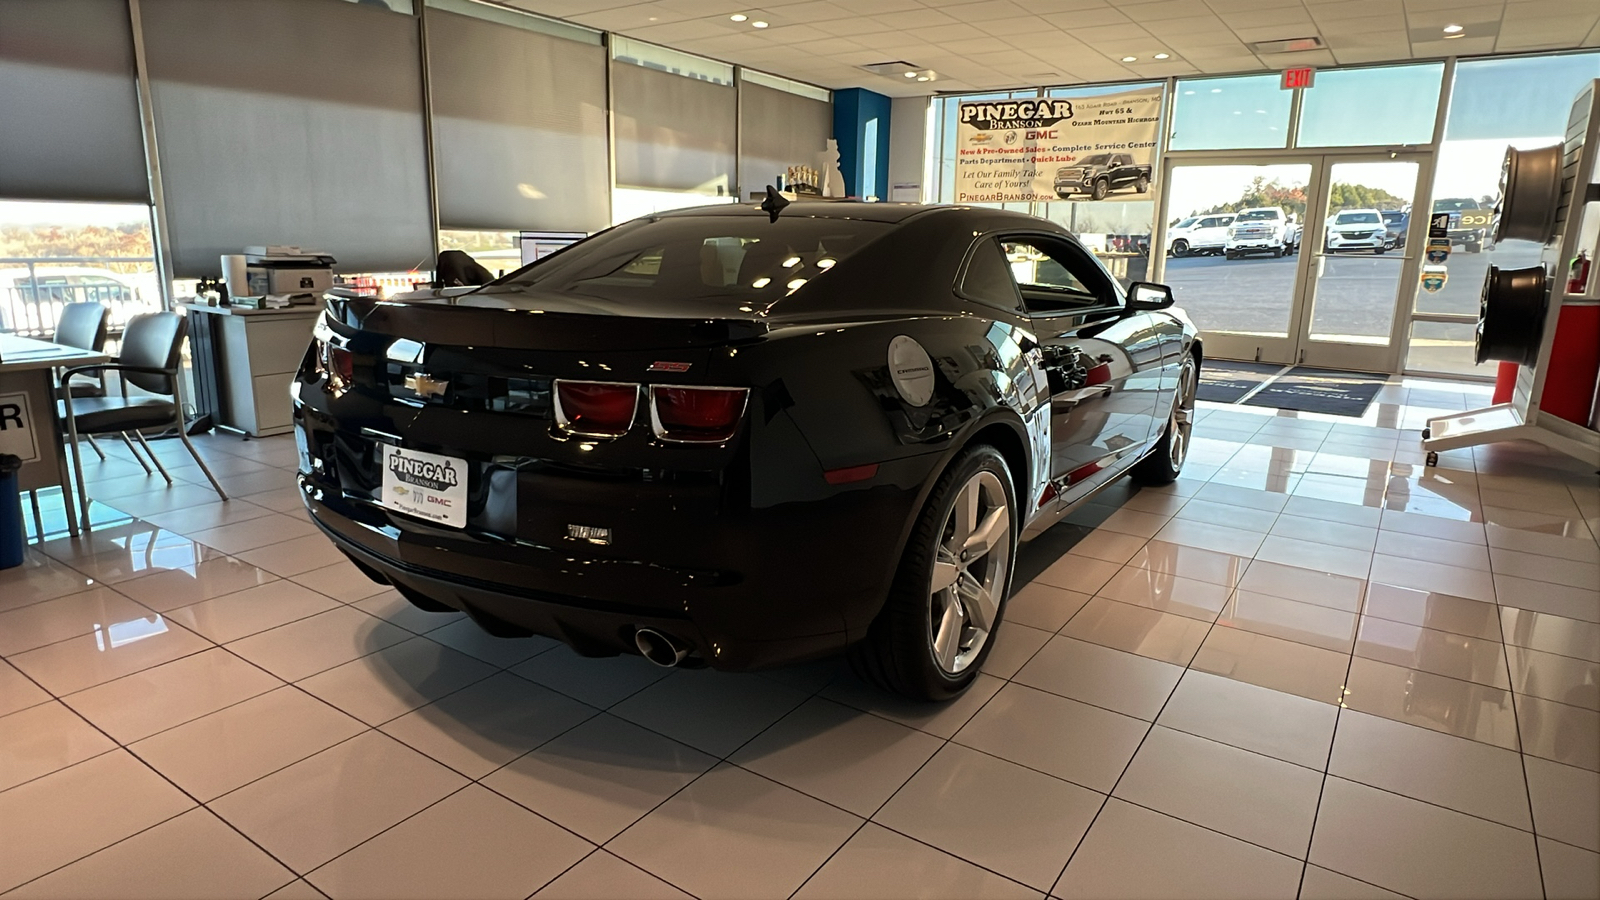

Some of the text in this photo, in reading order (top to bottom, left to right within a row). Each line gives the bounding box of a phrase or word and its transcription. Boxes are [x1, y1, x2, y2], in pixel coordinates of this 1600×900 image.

[1286, 68, 1311, 87] EXIT
[962, 101, 1072, 122] PINEGAR
[989, 119, 1043, 129] BRANSON
[1025, 130, 1058, 140] GMC
[983, 147, 1024, 155] Pre-Owned
[1052, 145, 1092, 153] Complete
[980, 157, 1026, 165] Department
[963, 171, 975, 179] Let
[993, 169, 1020, 178] Family
[1022, 170, 1043, 178] Take
[974, 180, 1030, 189] Care of Yours!
[390, 455, 457, 485] PINEGAR
[405, 473, 439, 489] BRANSON
[427, 495, 452, 507] GMC
